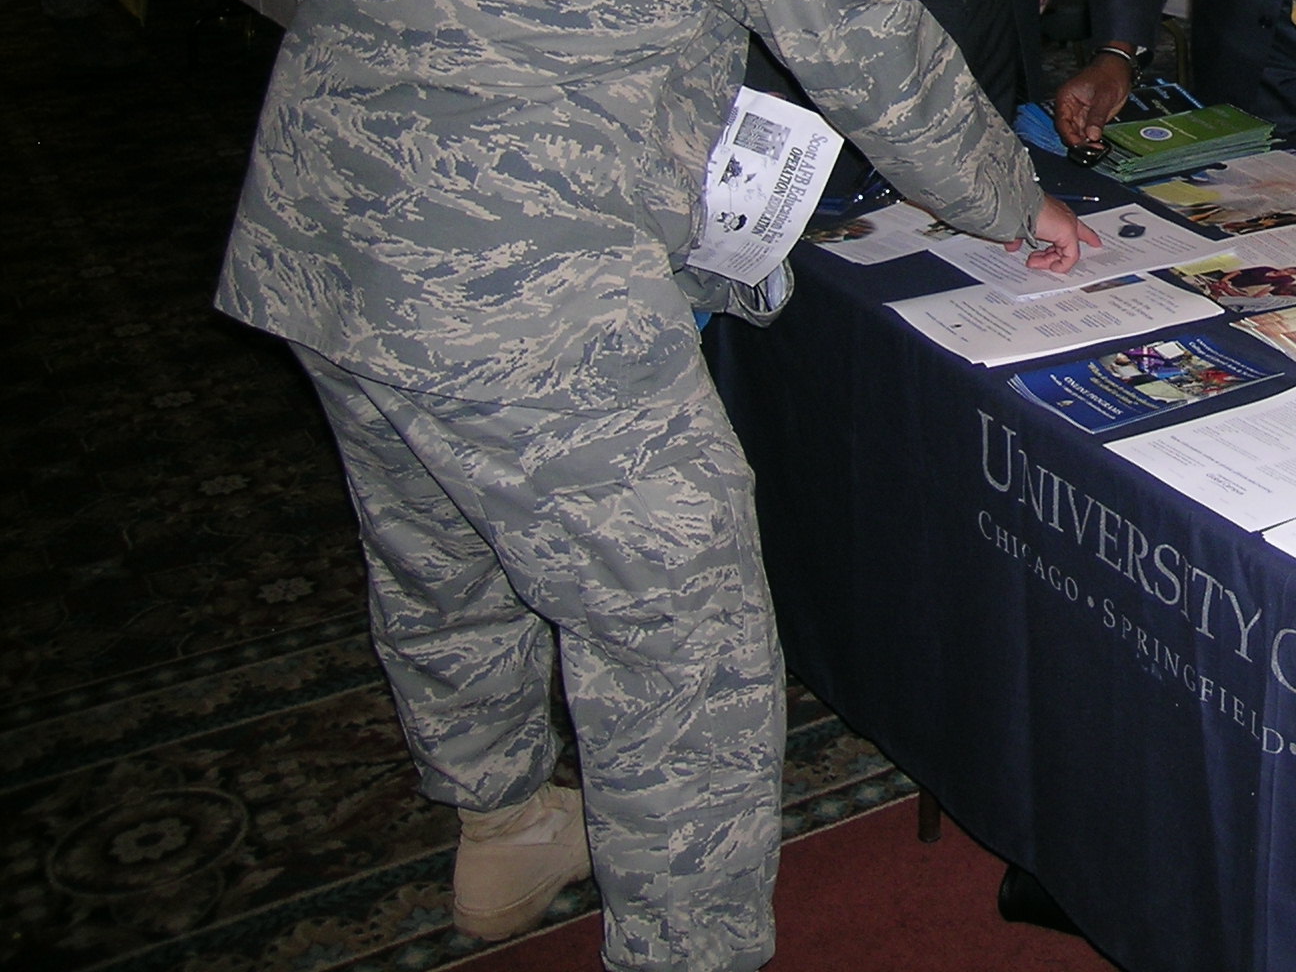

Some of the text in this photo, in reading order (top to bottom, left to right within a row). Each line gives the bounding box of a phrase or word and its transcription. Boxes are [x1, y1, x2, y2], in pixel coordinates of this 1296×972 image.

[804, 133, 828, 160] Scott
[977, 509, 1079, 602] CHICAGO
[1102, 597, 1285, 756] SPRINGFIELD
[980, 408, 1263, 663] UNIVERSITY
